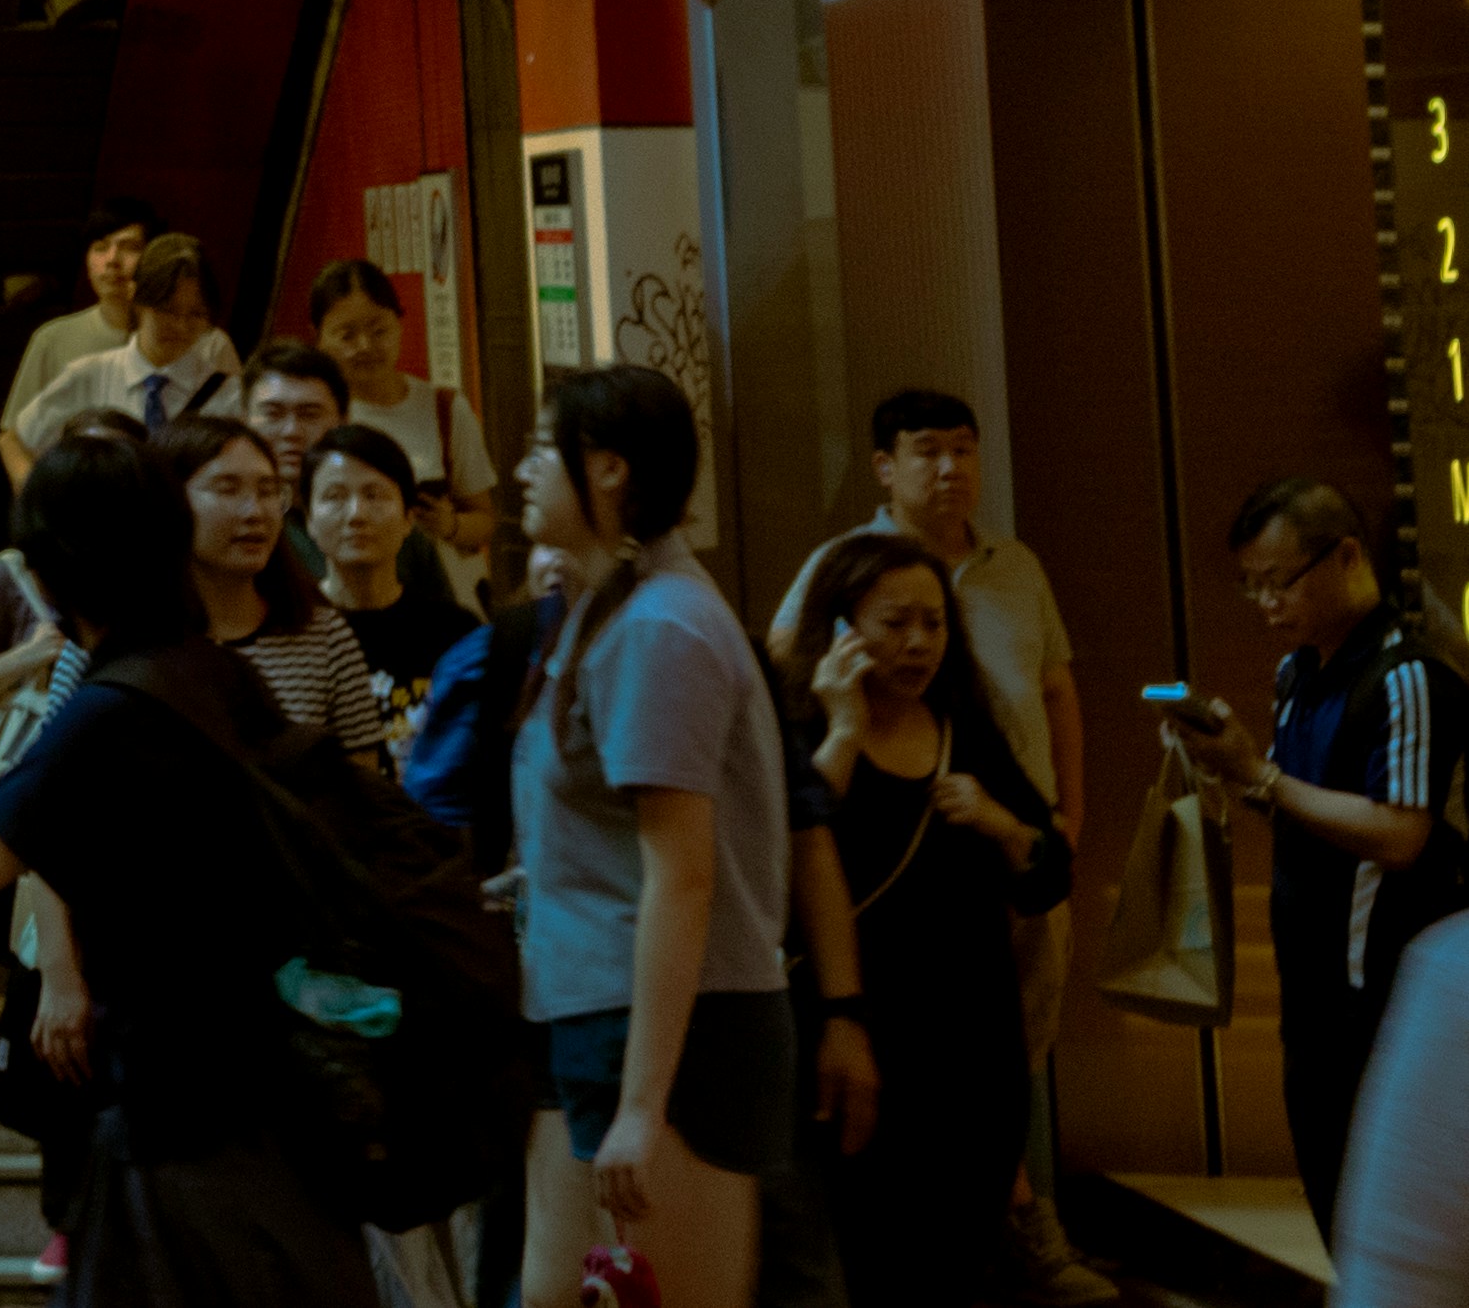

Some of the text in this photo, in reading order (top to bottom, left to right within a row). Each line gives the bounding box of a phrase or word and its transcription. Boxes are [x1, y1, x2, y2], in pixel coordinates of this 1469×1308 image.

[1427, 96, 1450, 163] 3
[1438, 217, 1459, 284] 2
[1448, 338, 1464, 403] 1
